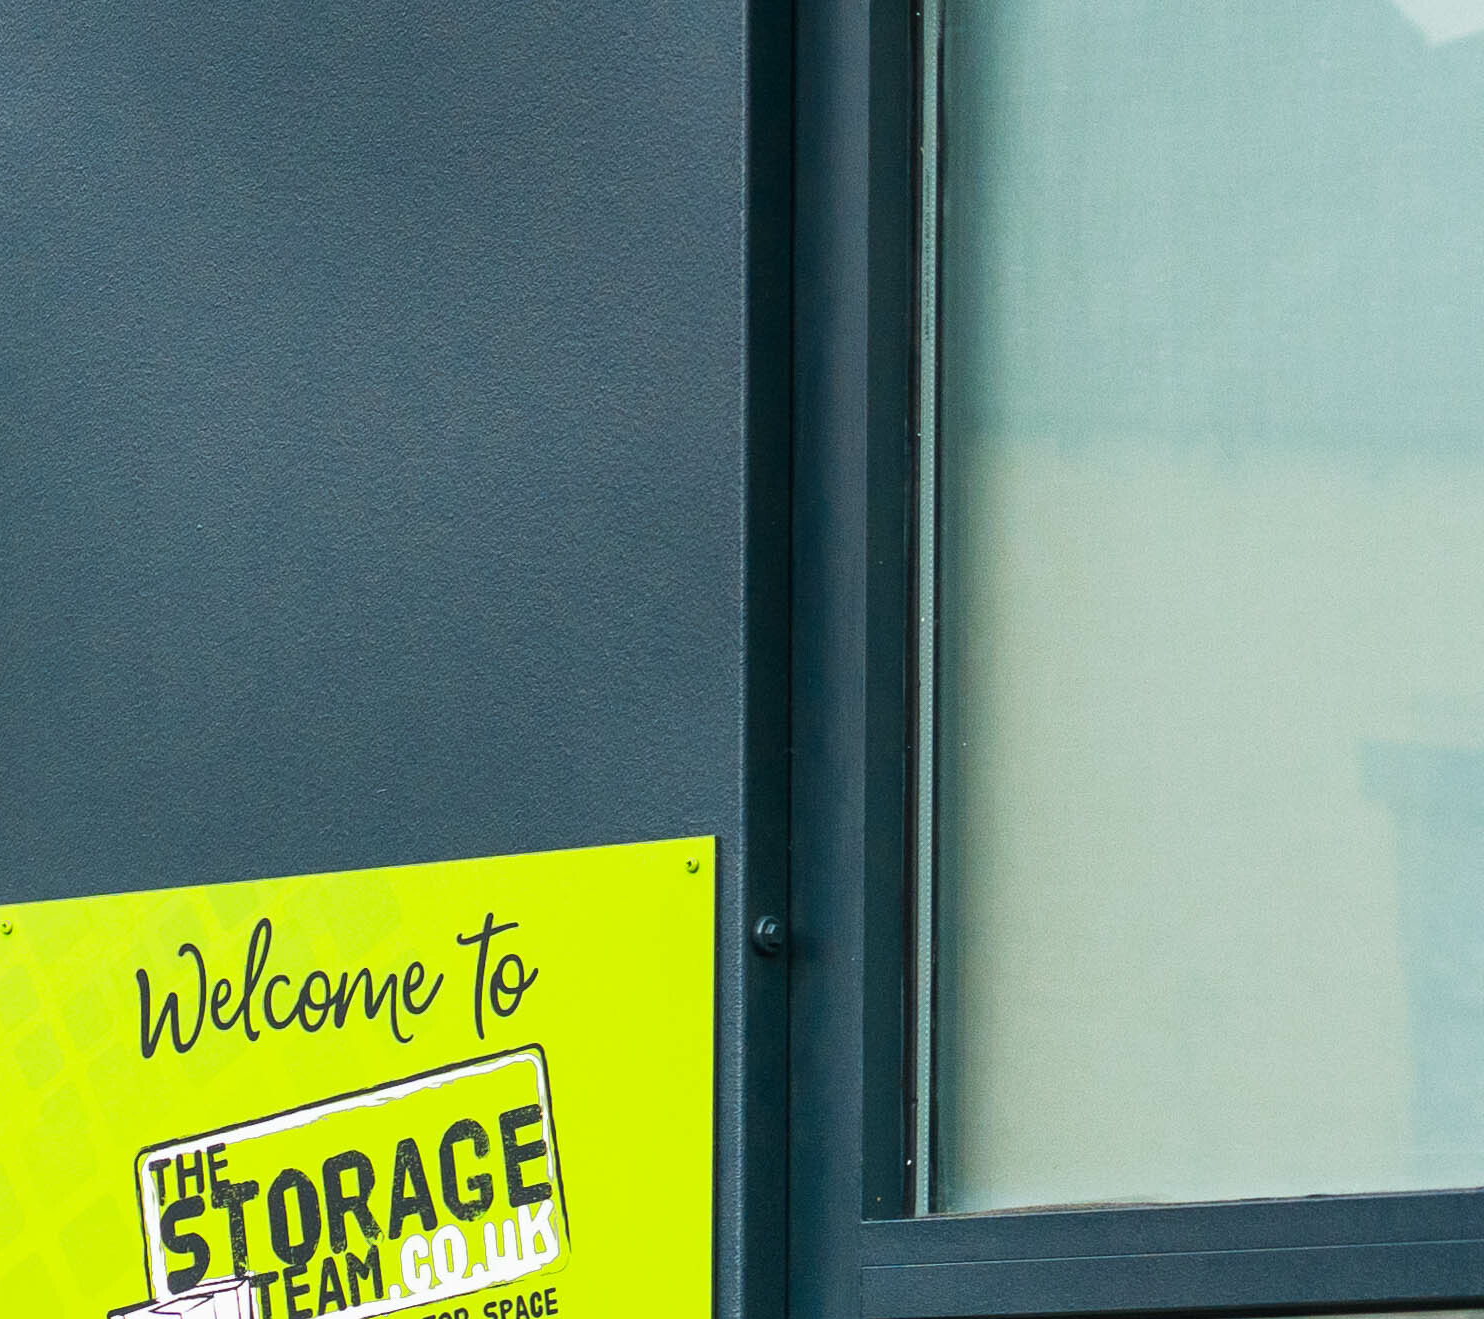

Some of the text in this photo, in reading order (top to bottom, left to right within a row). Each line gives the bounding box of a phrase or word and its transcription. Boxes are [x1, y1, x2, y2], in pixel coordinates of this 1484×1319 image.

[137, 918, 444, 1058] Welcome
[149, 1143, 227, 1203] THE
[158, 1104, 554, 1295] STORAGE
